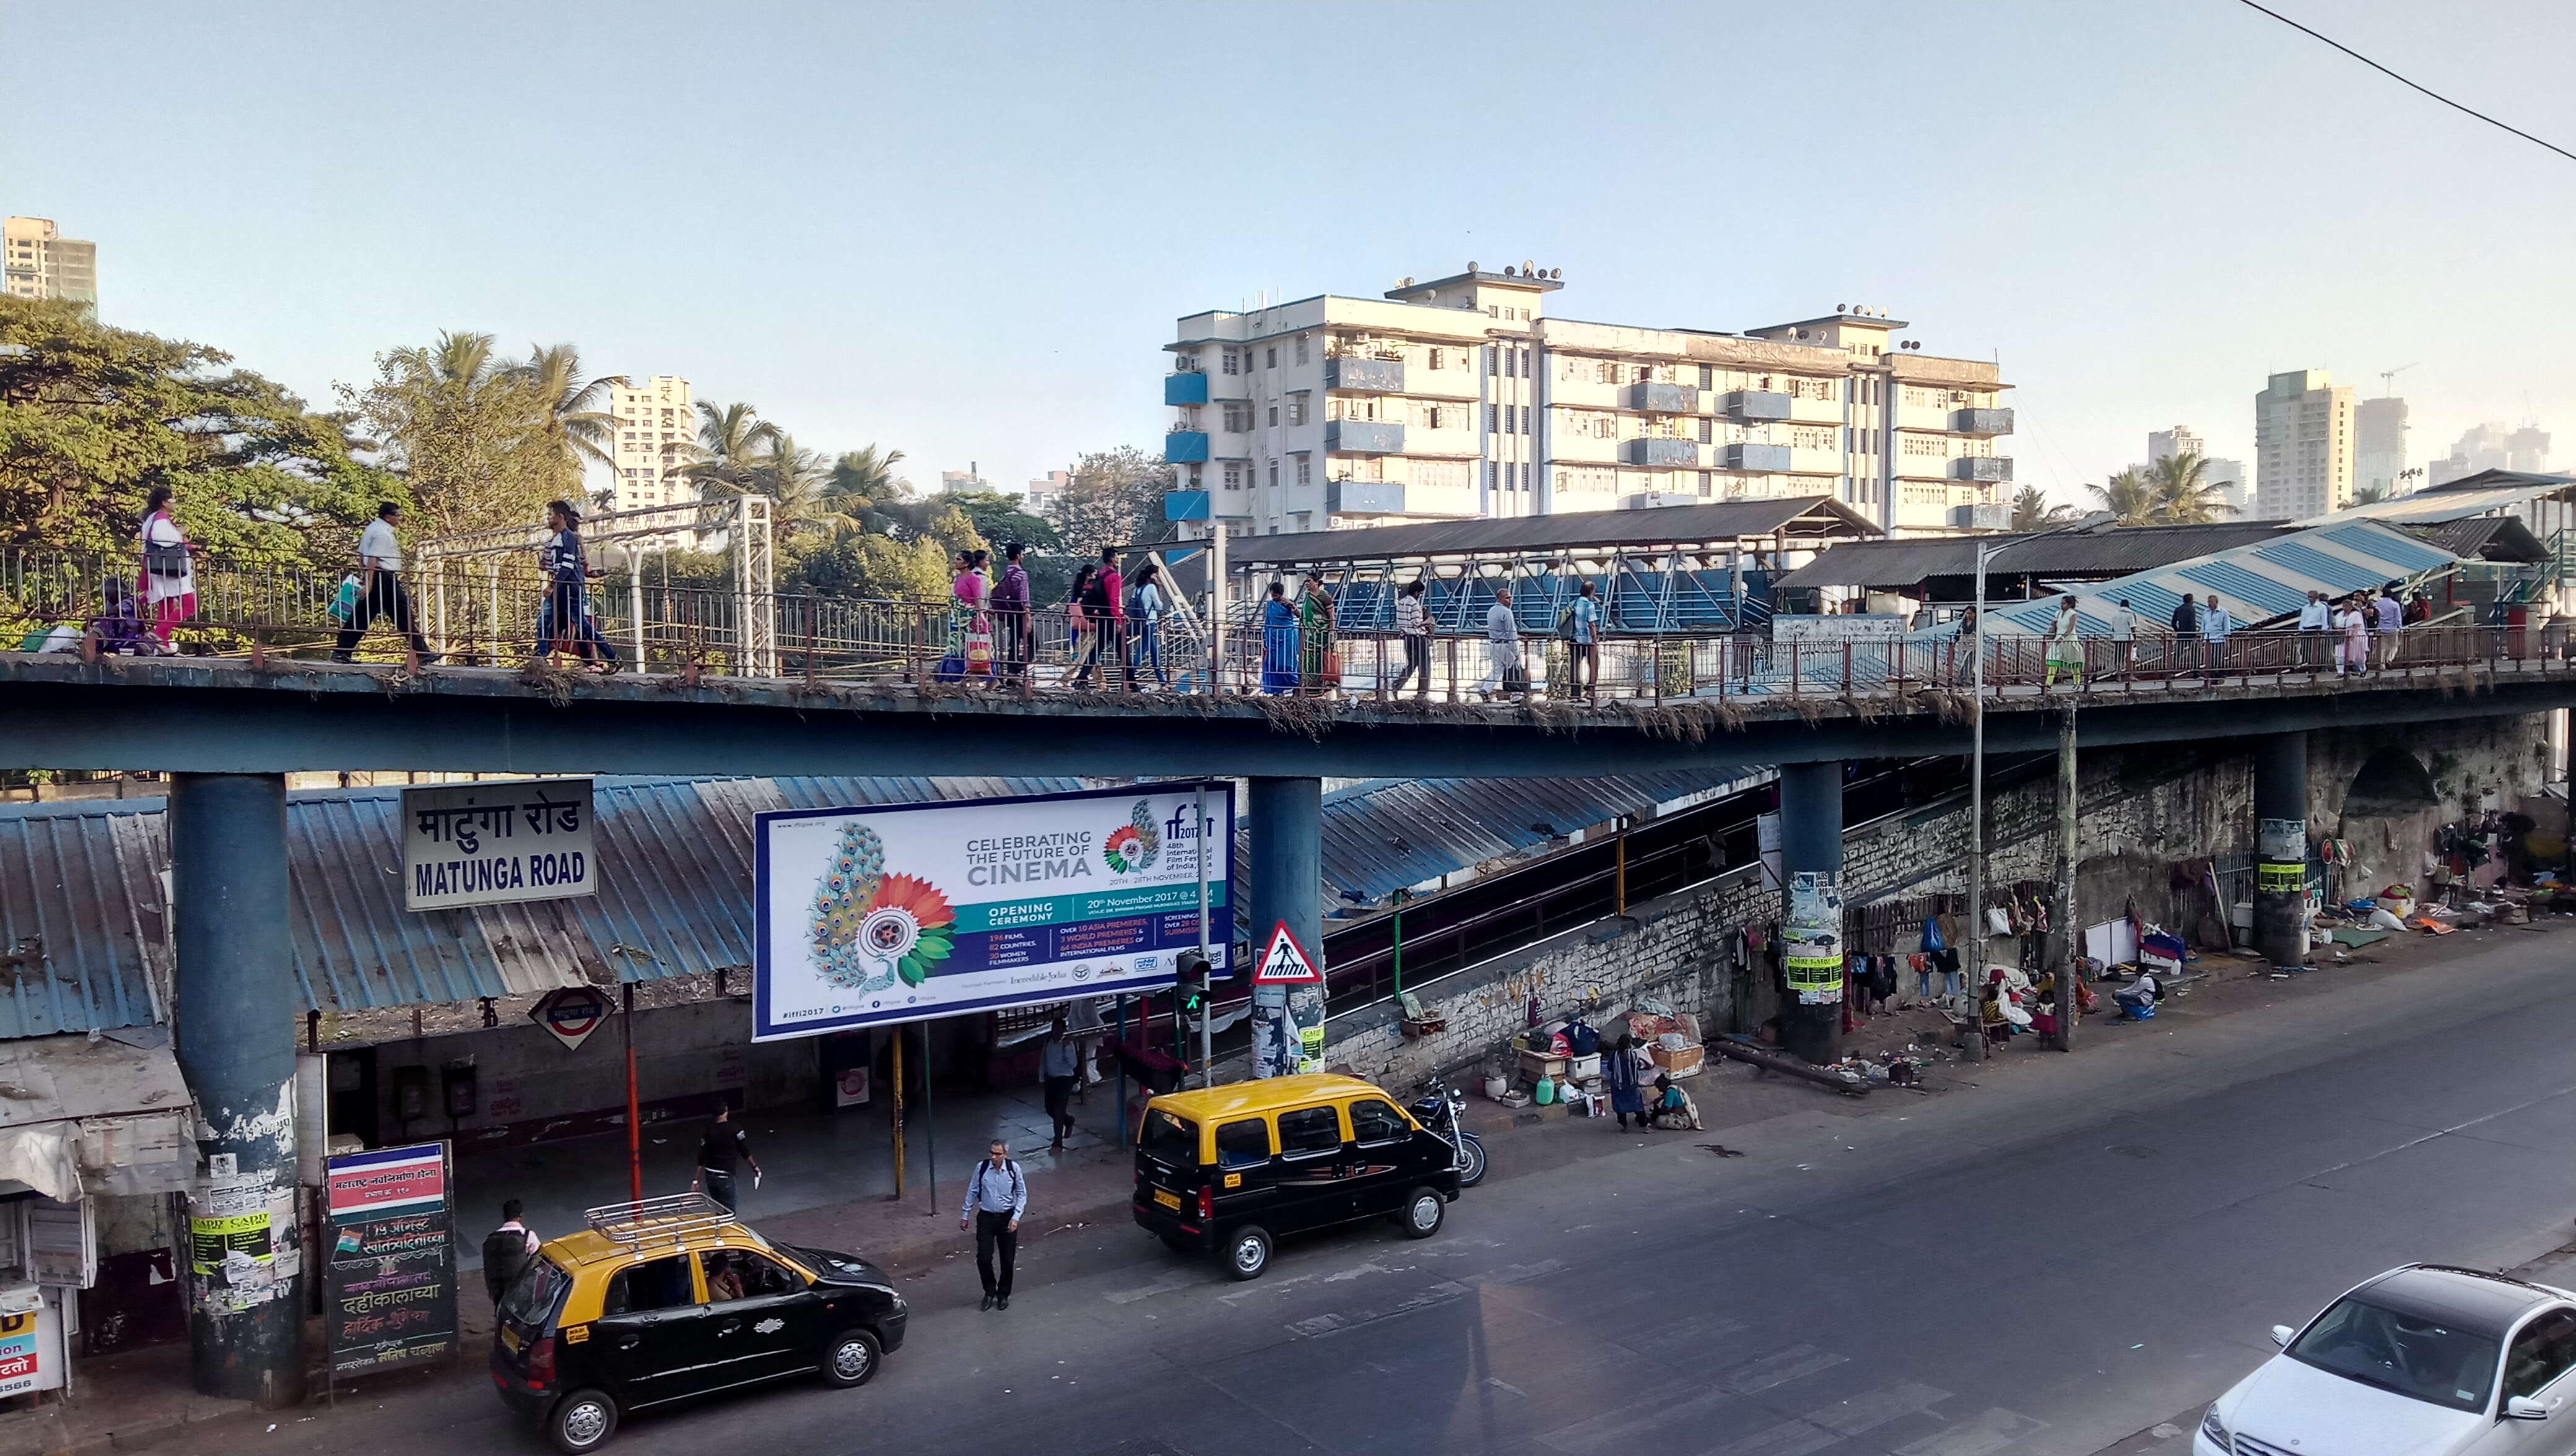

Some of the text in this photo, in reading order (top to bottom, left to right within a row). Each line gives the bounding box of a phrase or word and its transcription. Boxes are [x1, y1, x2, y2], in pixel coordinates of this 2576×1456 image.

[417, 790, 581, 854] माटुंगा रोड
[967, 831, 1091, 852] CELEBRATING
[967, 845, 1089, 864] THE FUTURE OF
[1167, 847, 1212, 856] Internatial
[416, 851, 585, 896] MATUNGA ROAD
[967, 857, 1092, 886] CINEMA
[1107, 896, 1153, 906] November
[1155, 892, 1177, 902] 2017
[1180, 891, 1188, 900] @
[989, 903, 1053, 917] OPENING
[989, 912, 1053, 925] CEREMONY
[1067, 934, 1095, 942] WORLD
[1060, 948, 1107, 957] INTERNATIONAL
[989, 956, 1029, 966] FILMMAKERS
[341, 1284, 441, 1314] दहीकालाच्या
